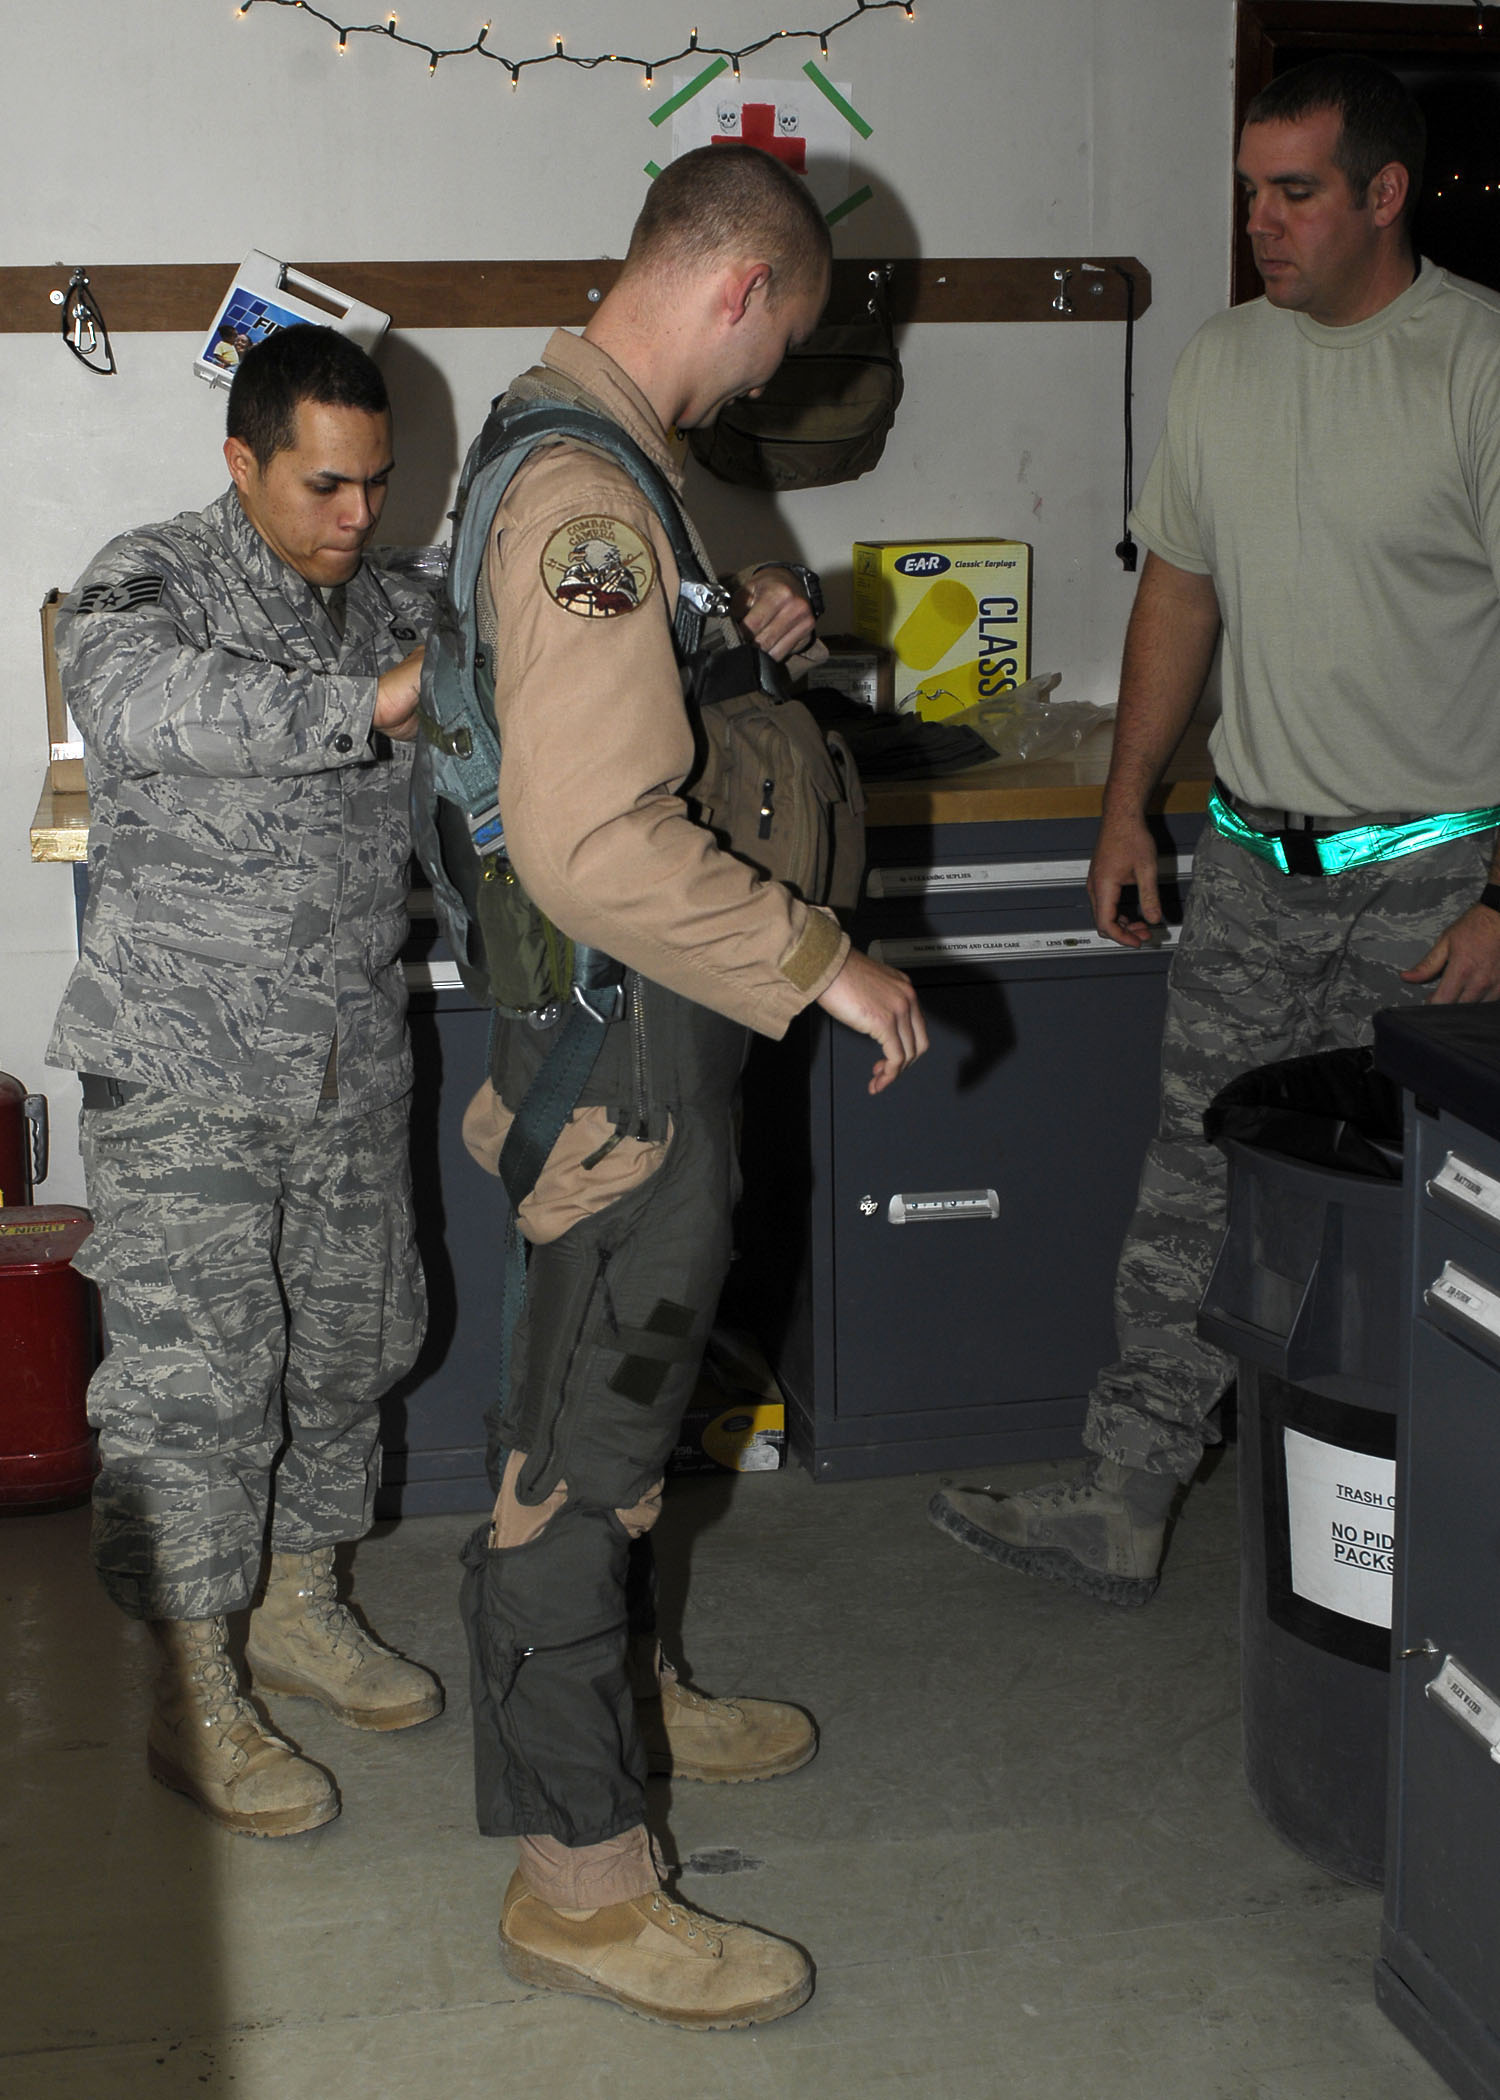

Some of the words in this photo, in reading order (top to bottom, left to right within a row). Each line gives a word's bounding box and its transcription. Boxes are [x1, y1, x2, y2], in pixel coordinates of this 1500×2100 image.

[567, 519, 616, 536] COMBAT
[569, 530, 616, 546] CAMERA
[985, 560, 1016, 569] Earplugs
[1336, 1483, 1383, 1506] TRASH
[1332, 1521, 1358, 1542] NO
[1335, 1543, 1394, 1572] PACKS
